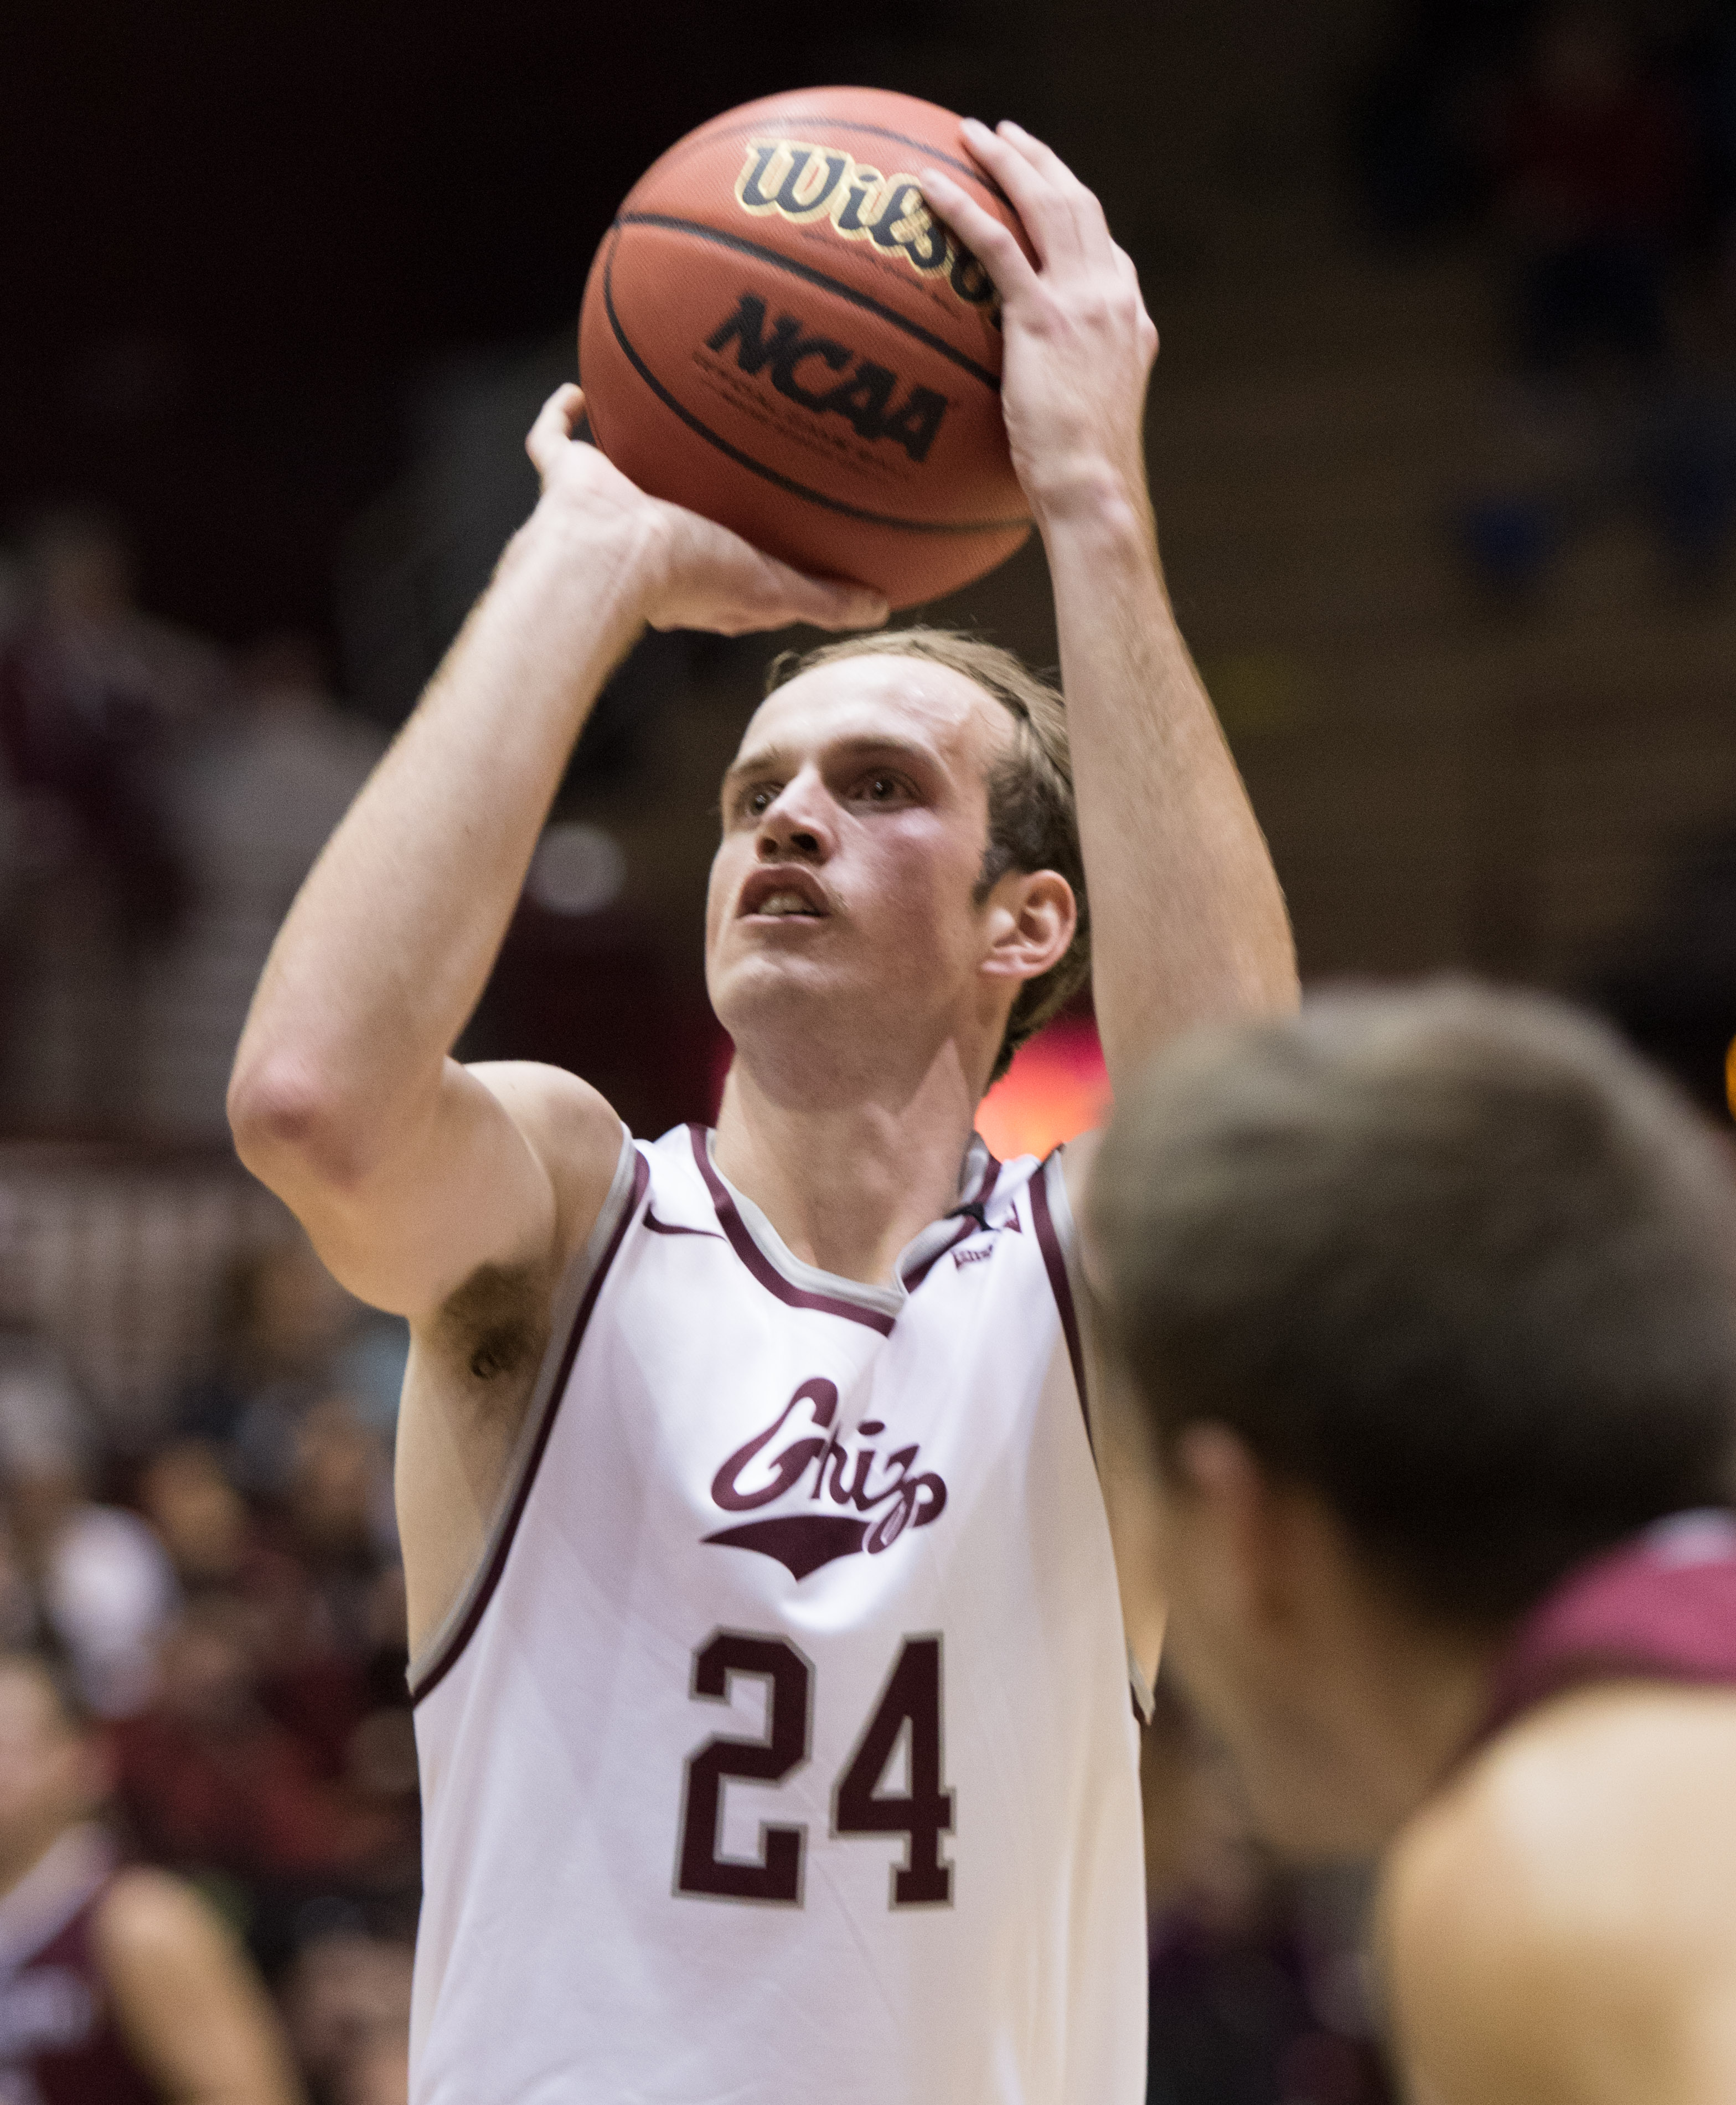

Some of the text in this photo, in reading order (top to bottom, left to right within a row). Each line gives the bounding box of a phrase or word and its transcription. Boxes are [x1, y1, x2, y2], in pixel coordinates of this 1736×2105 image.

[735, 138, 1003, 333] Wilso
[705, 291, 948, 463] NCAA
[711, 1377, 948, 1555] Griz
[671, 1625, 957, 1911] 24
